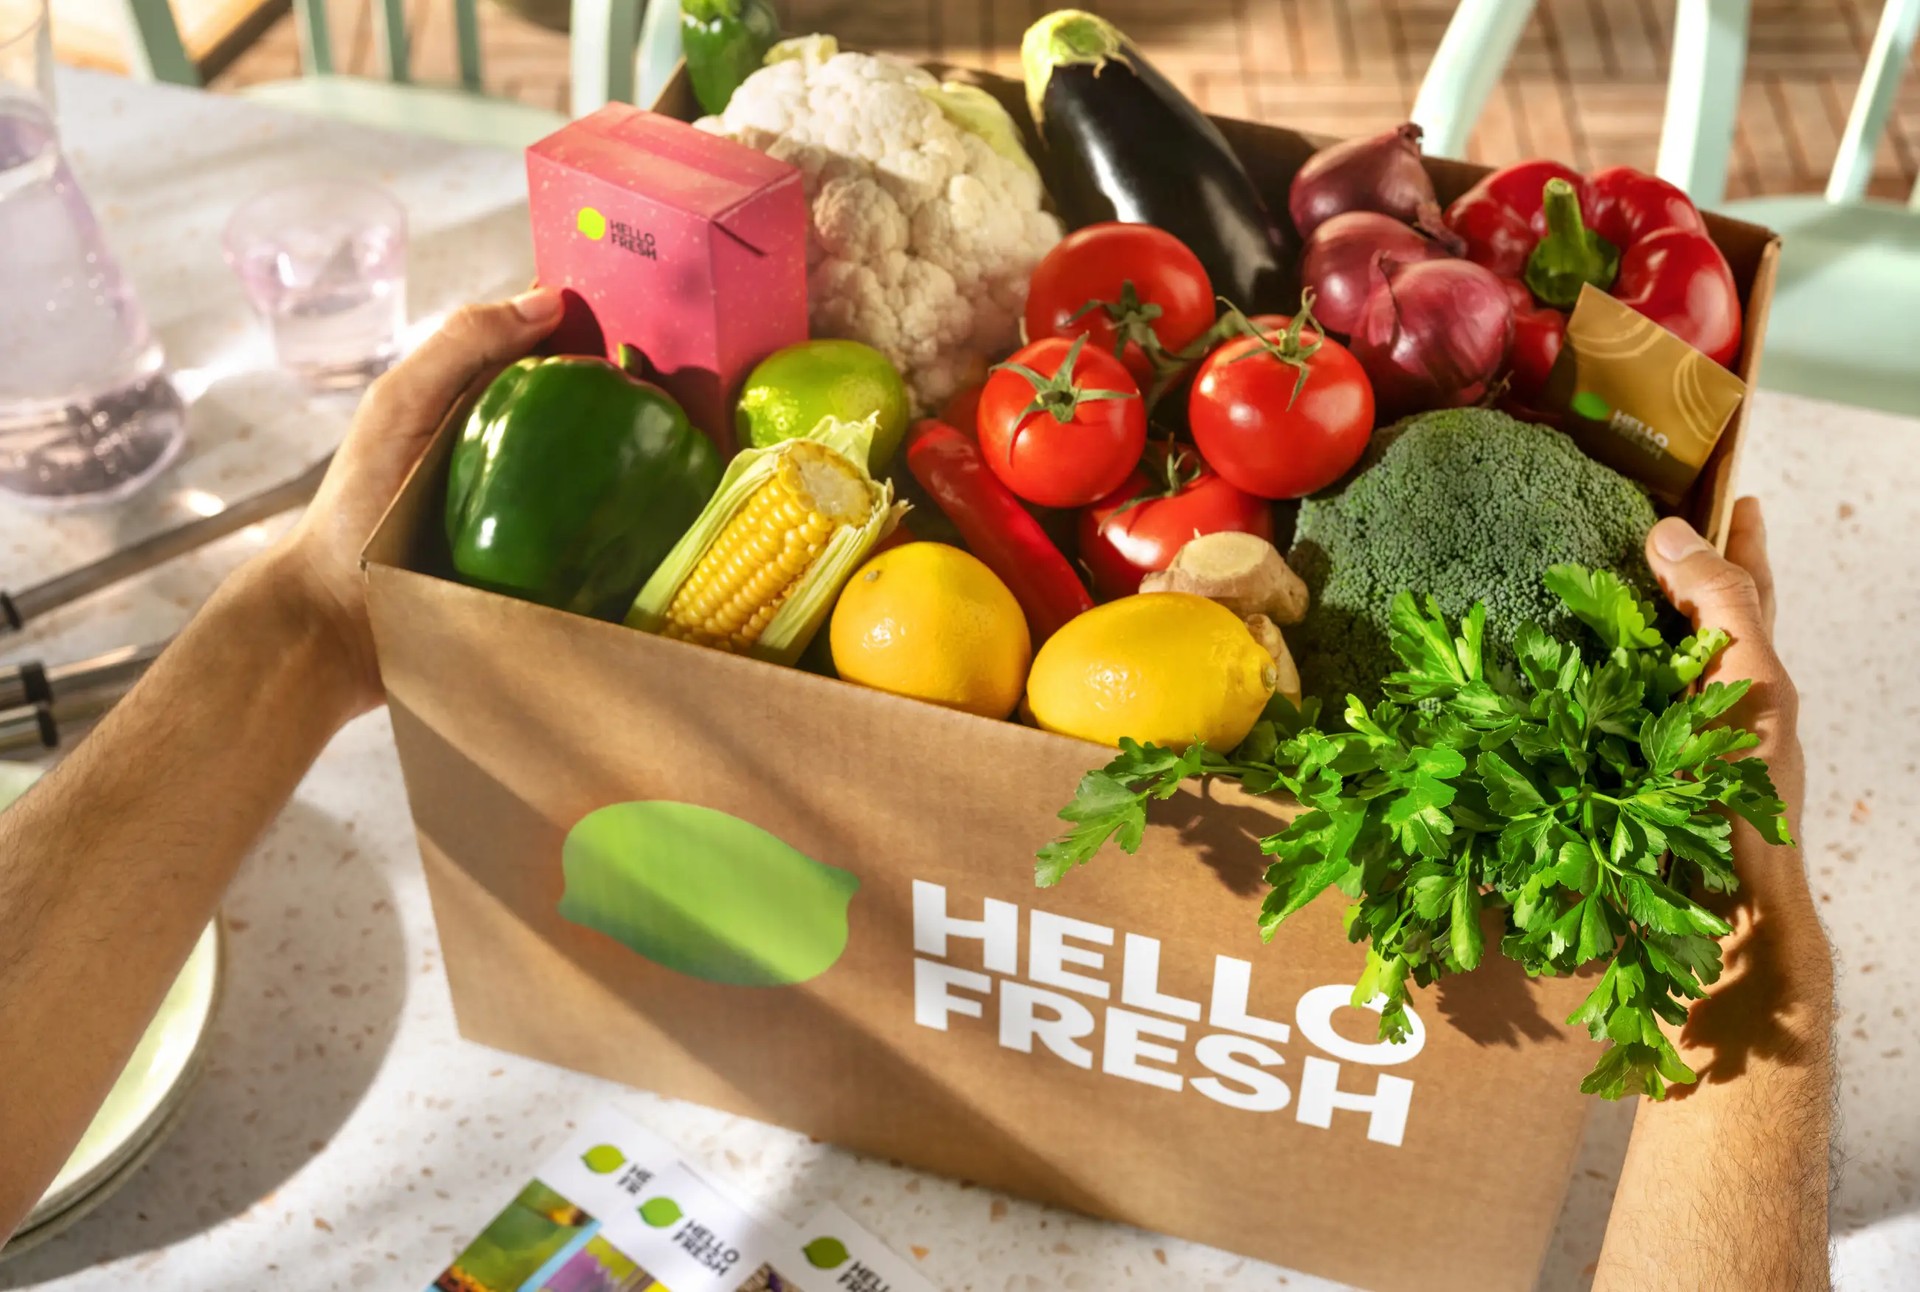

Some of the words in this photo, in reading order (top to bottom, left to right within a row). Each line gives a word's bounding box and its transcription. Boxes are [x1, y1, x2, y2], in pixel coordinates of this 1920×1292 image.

[610, 219, 656, 247] HELLO
[611, 232, 657, 261] FRESH
[1613, 409, 1669, 449] HELLO
[912, 879, 1426, 1066] HELLO
[914, 957, 1415, 1147] FRESH
[672, 1231, 729, 1277] FRESH
[684, 1219, 741, 1264] HELLO
